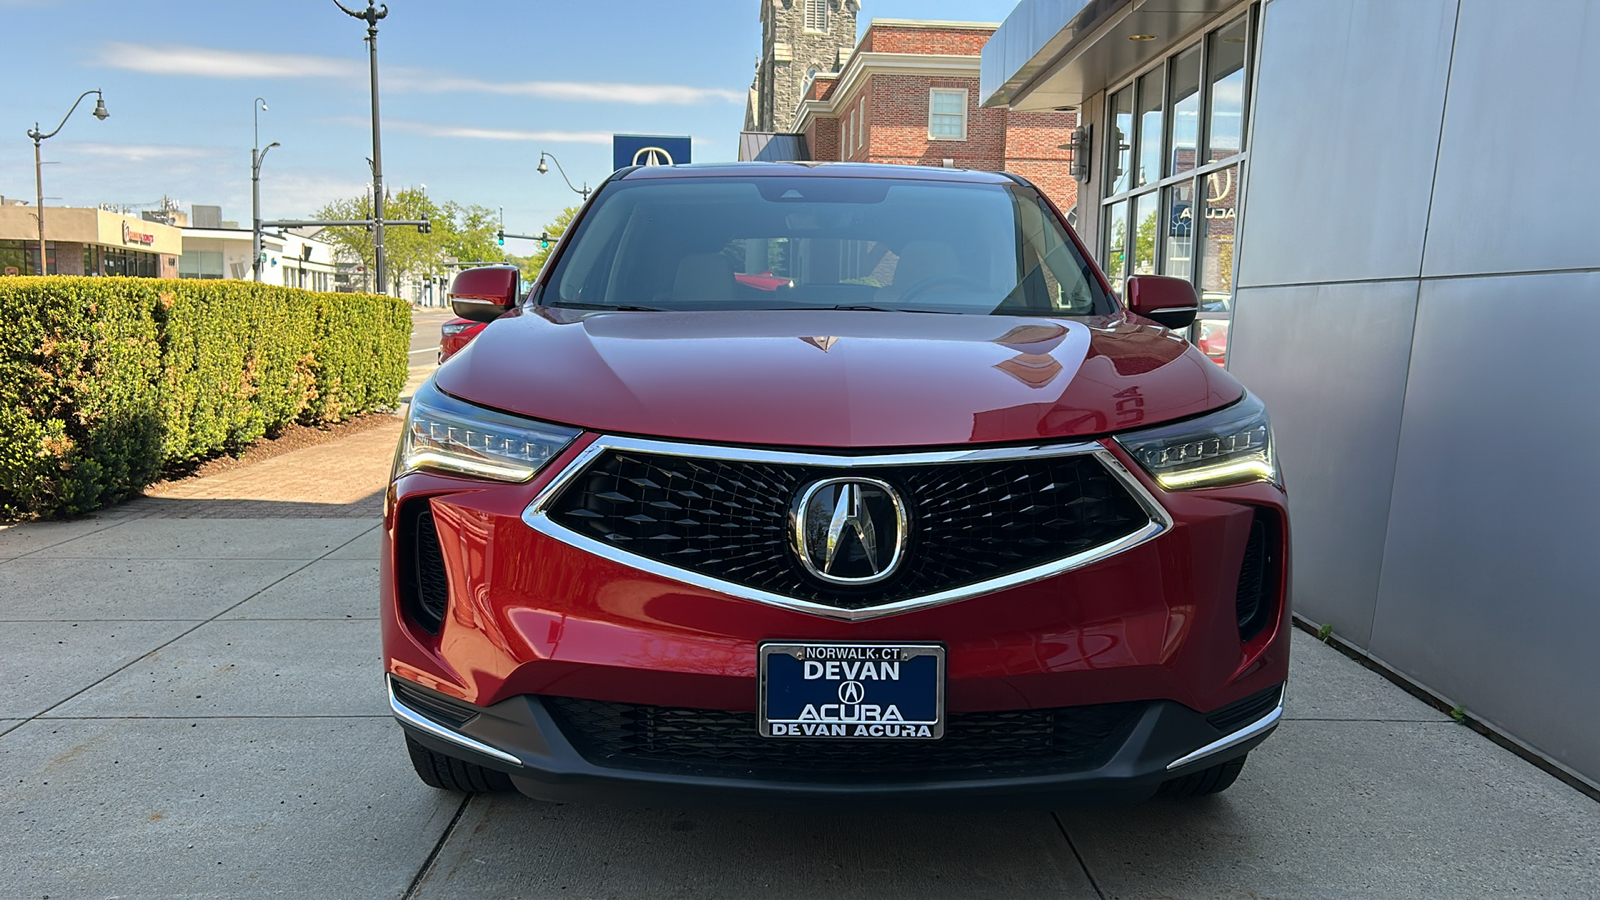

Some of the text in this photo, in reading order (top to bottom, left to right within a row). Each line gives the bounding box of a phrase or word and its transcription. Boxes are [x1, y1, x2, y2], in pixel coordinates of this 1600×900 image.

[881, 648, 900, 660] CT
[803, 661, 899, 681] DEVAN
[798, 703, 904, 721] ACURA
[772, 723, 932, 738] DEVAN ACURA
